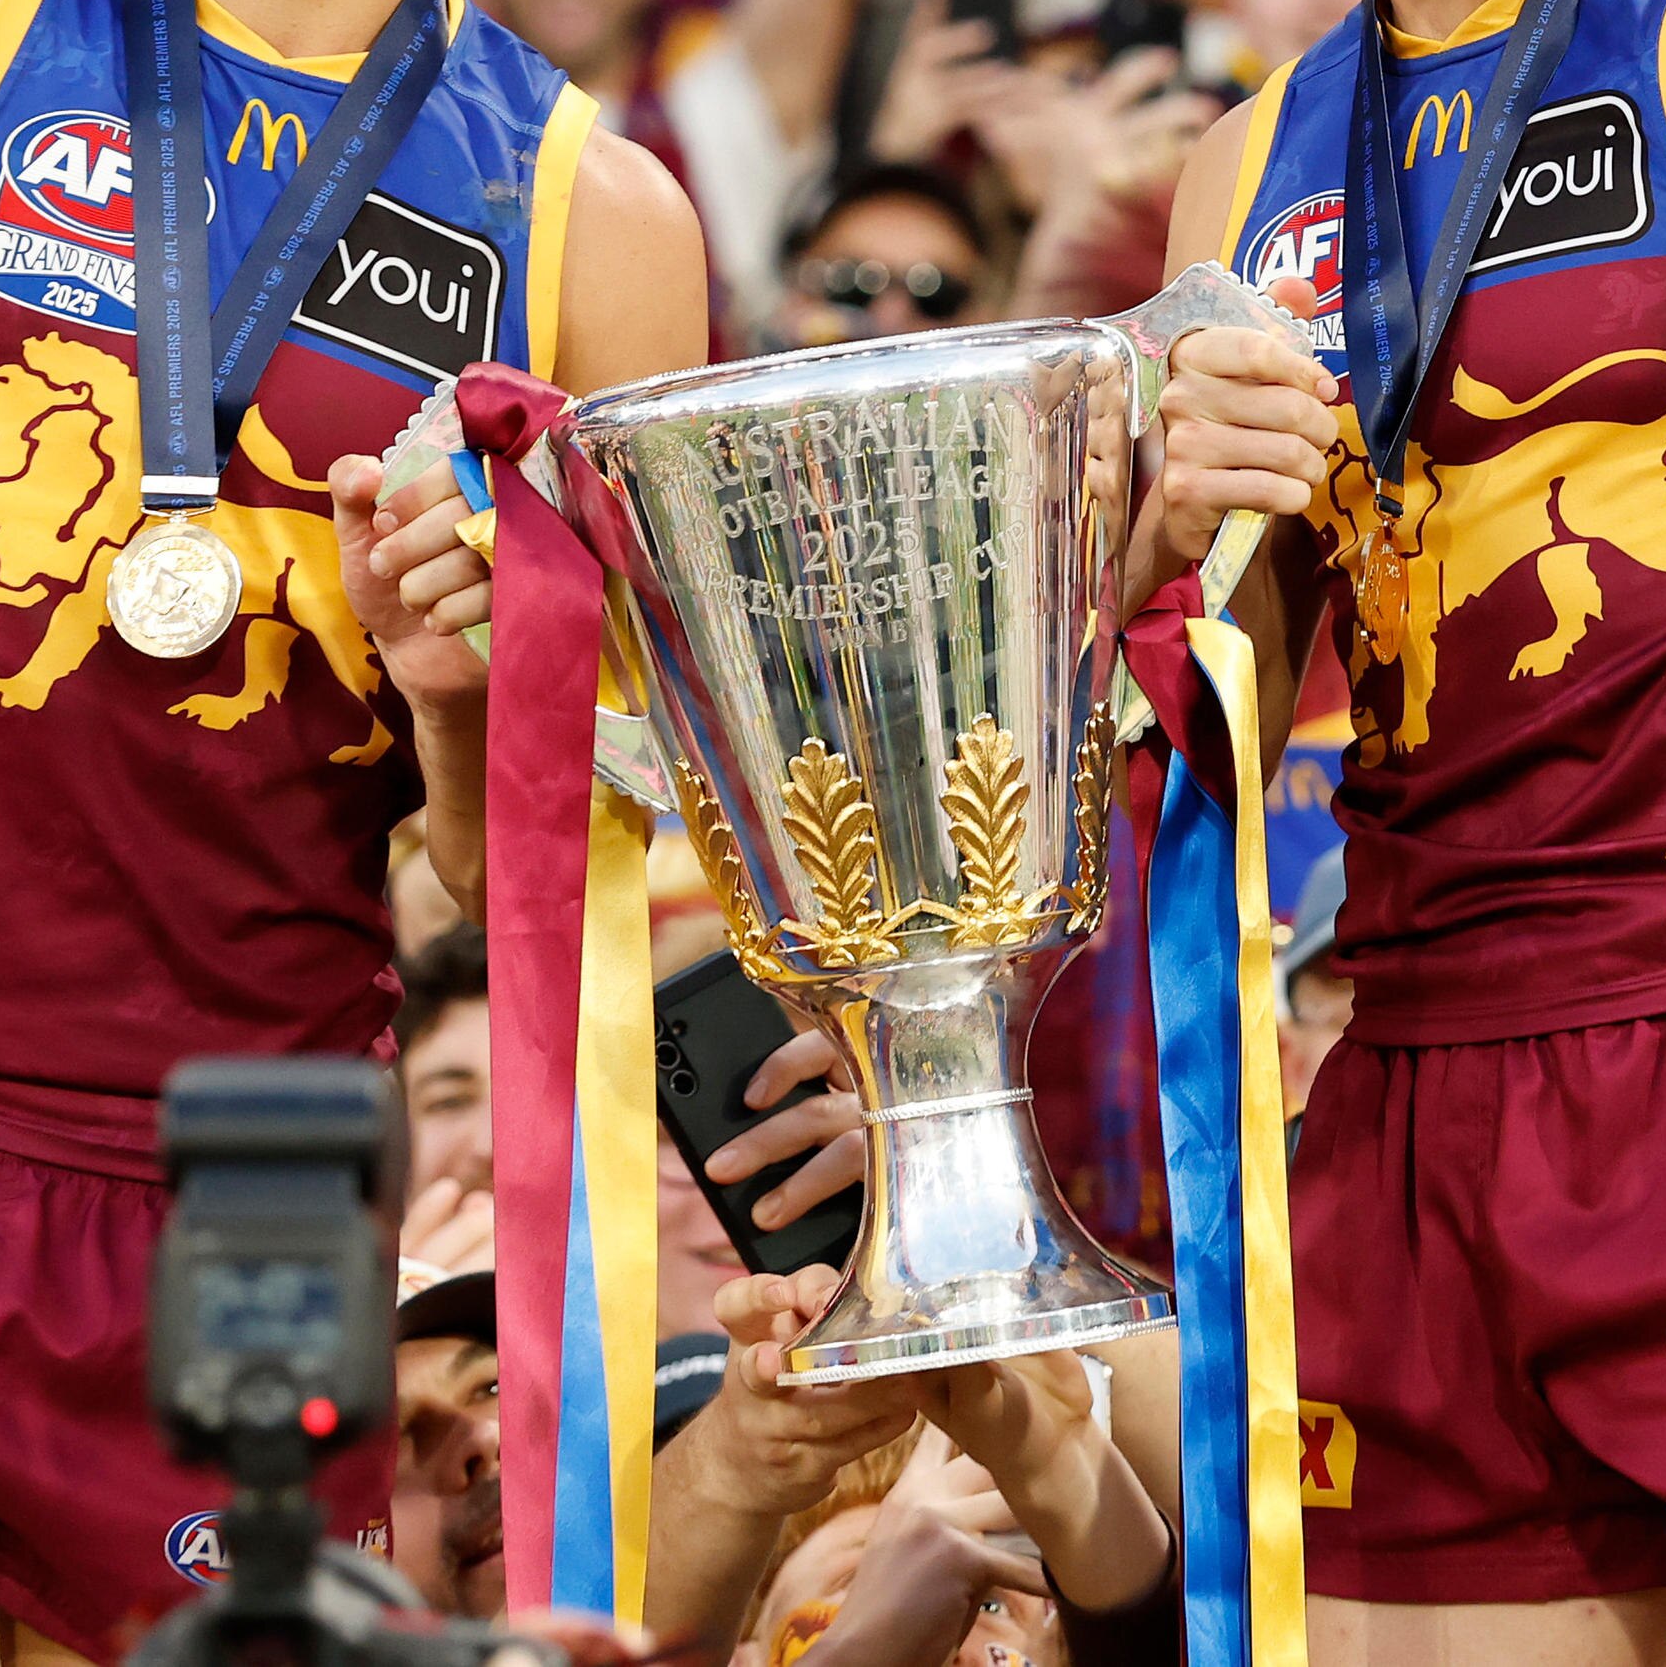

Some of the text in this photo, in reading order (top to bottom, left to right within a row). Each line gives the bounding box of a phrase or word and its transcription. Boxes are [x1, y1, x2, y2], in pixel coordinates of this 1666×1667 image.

[153, 18, 171, 78] PREMIERS
[359, 32, 426, 133] AFL PREMIERS 2025
[1503, 91, 1518, 115] AFL
[1514, 26, 1545, 90] PREMIERS
[158, 80, 171, 103] AFL
[17, 131, 134, 205] AF
[161, 137, 178, 263] AFL PREMIERS 2025
[1489, 124, 1615, 239] youi
[278, 157, 350, 261] AFL PREMIERS 2025
[1446, 149, 1496, 270] AFL PREMIERS 2025
[41, 281, 100, 317] 2025
[248, 291, 270, 312] AFL
[327, 237, 474, 334] youi
[1367, 278, 1382, 306] AFL
[166, 299, 184, 426] AFL PREMIERS 2025
[218, 315, 258, 376] PREMIERS
[1370, 303, 1391, 362] PREMIERS
[683, 392, 1018, 492] AUSTRALIAN
[884, 461, 1035, 510] LEAGUE
[703, 519, 1027, 621] PREMIERSHIP CUP
[801, 516, 921, 575] 2025
